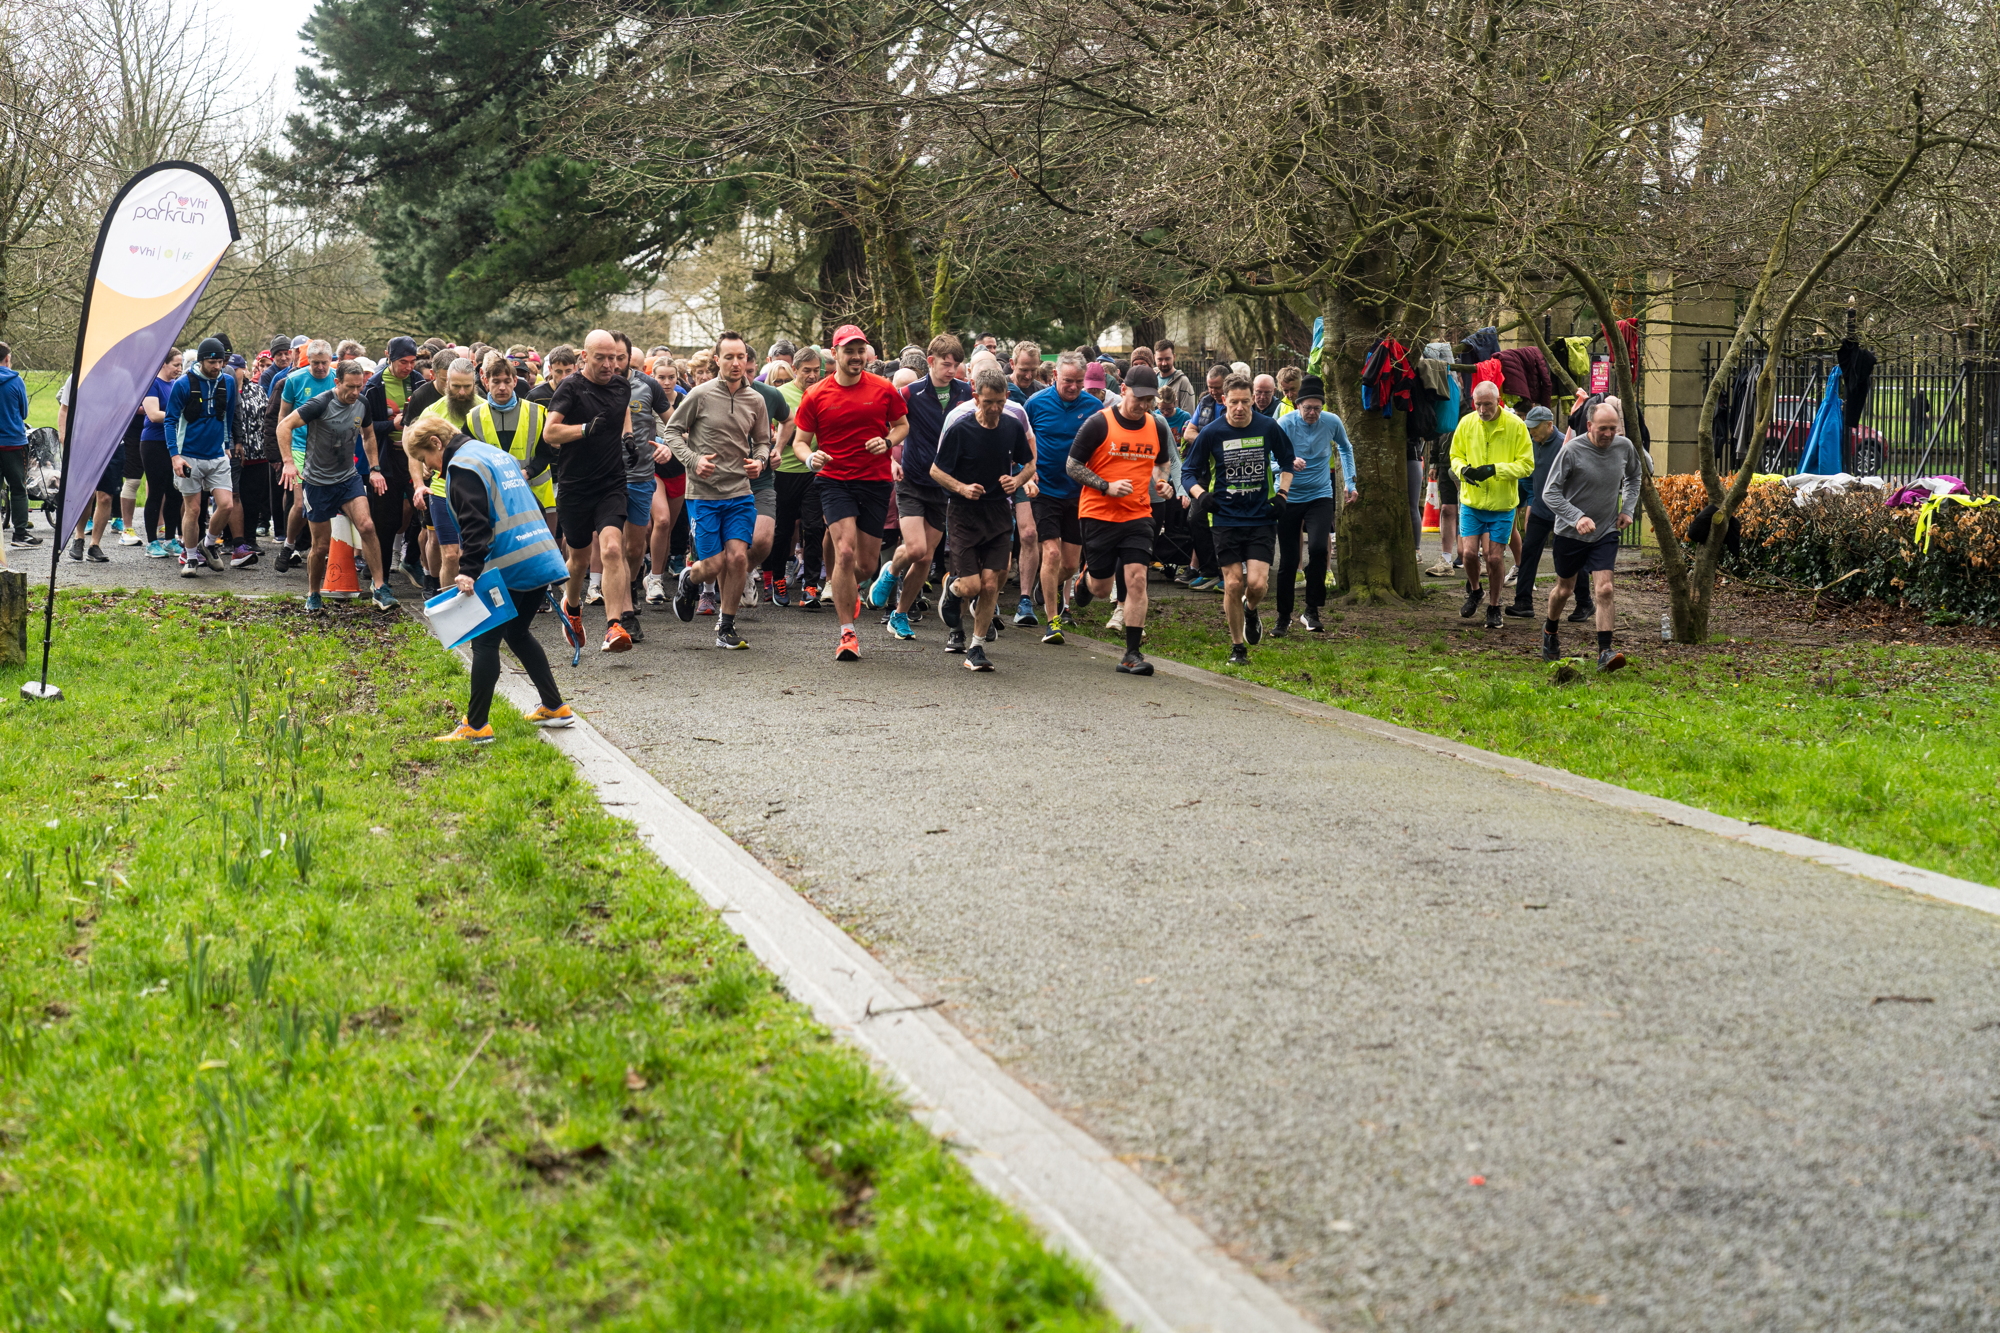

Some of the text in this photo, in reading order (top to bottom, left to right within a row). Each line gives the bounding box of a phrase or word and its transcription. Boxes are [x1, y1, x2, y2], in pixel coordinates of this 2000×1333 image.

[190, 197, 208, 209] Vhi
[132, 200, 205, 225] parkrun
[139, 246, 156, 257] Vhi
[504, 470, 516, 479] RUN
[1226, 462, 1265, 479] pride!
[516, 532, 533, 541] Thanks
